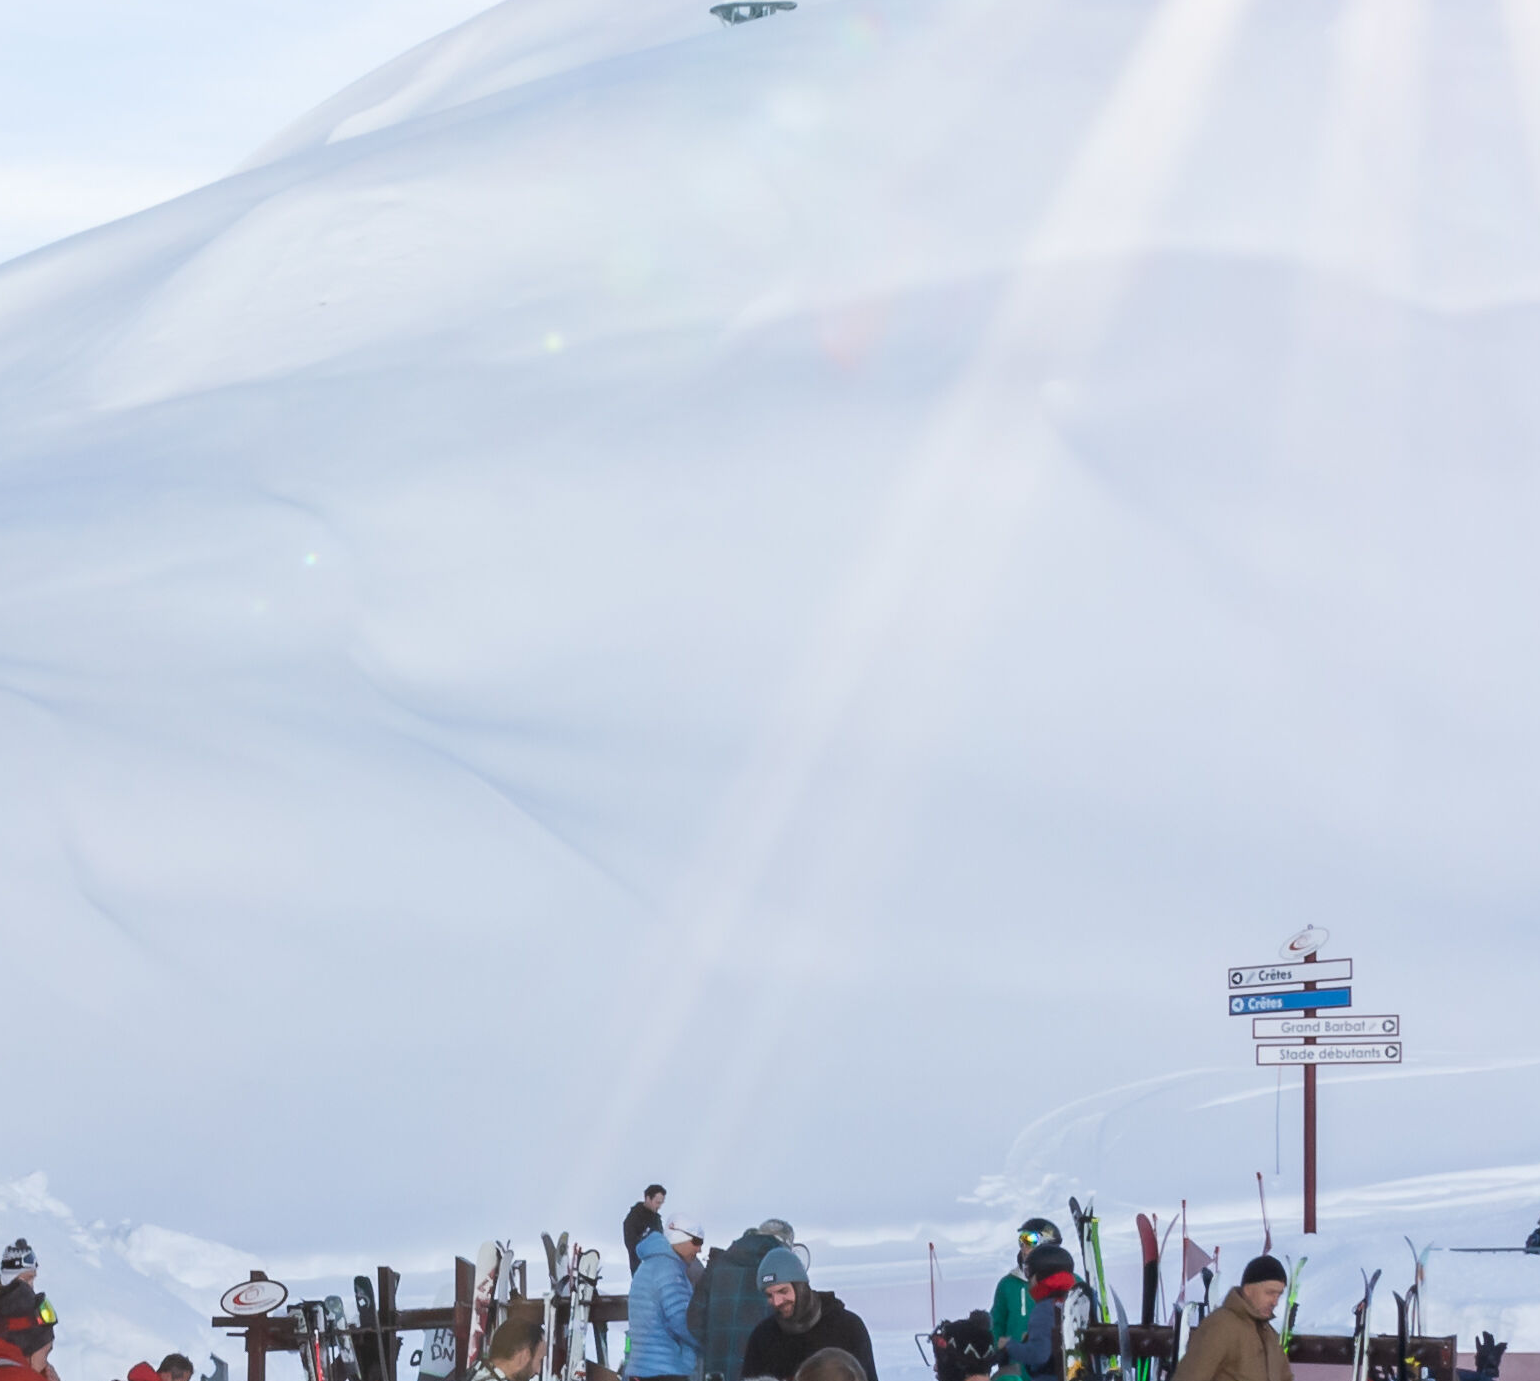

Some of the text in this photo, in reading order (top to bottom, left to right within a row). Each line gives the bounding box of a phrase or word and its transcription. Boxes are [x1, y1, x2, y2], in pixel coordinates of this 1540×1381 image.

[1258, 967, 1292, 982] Crêtes
[1248, 996, 1283, 1010] Crêtes
[1281, 1019, 1365, 1034] Grand Barbat
[1279, 1046, 1381, 1060] Stade débutants
